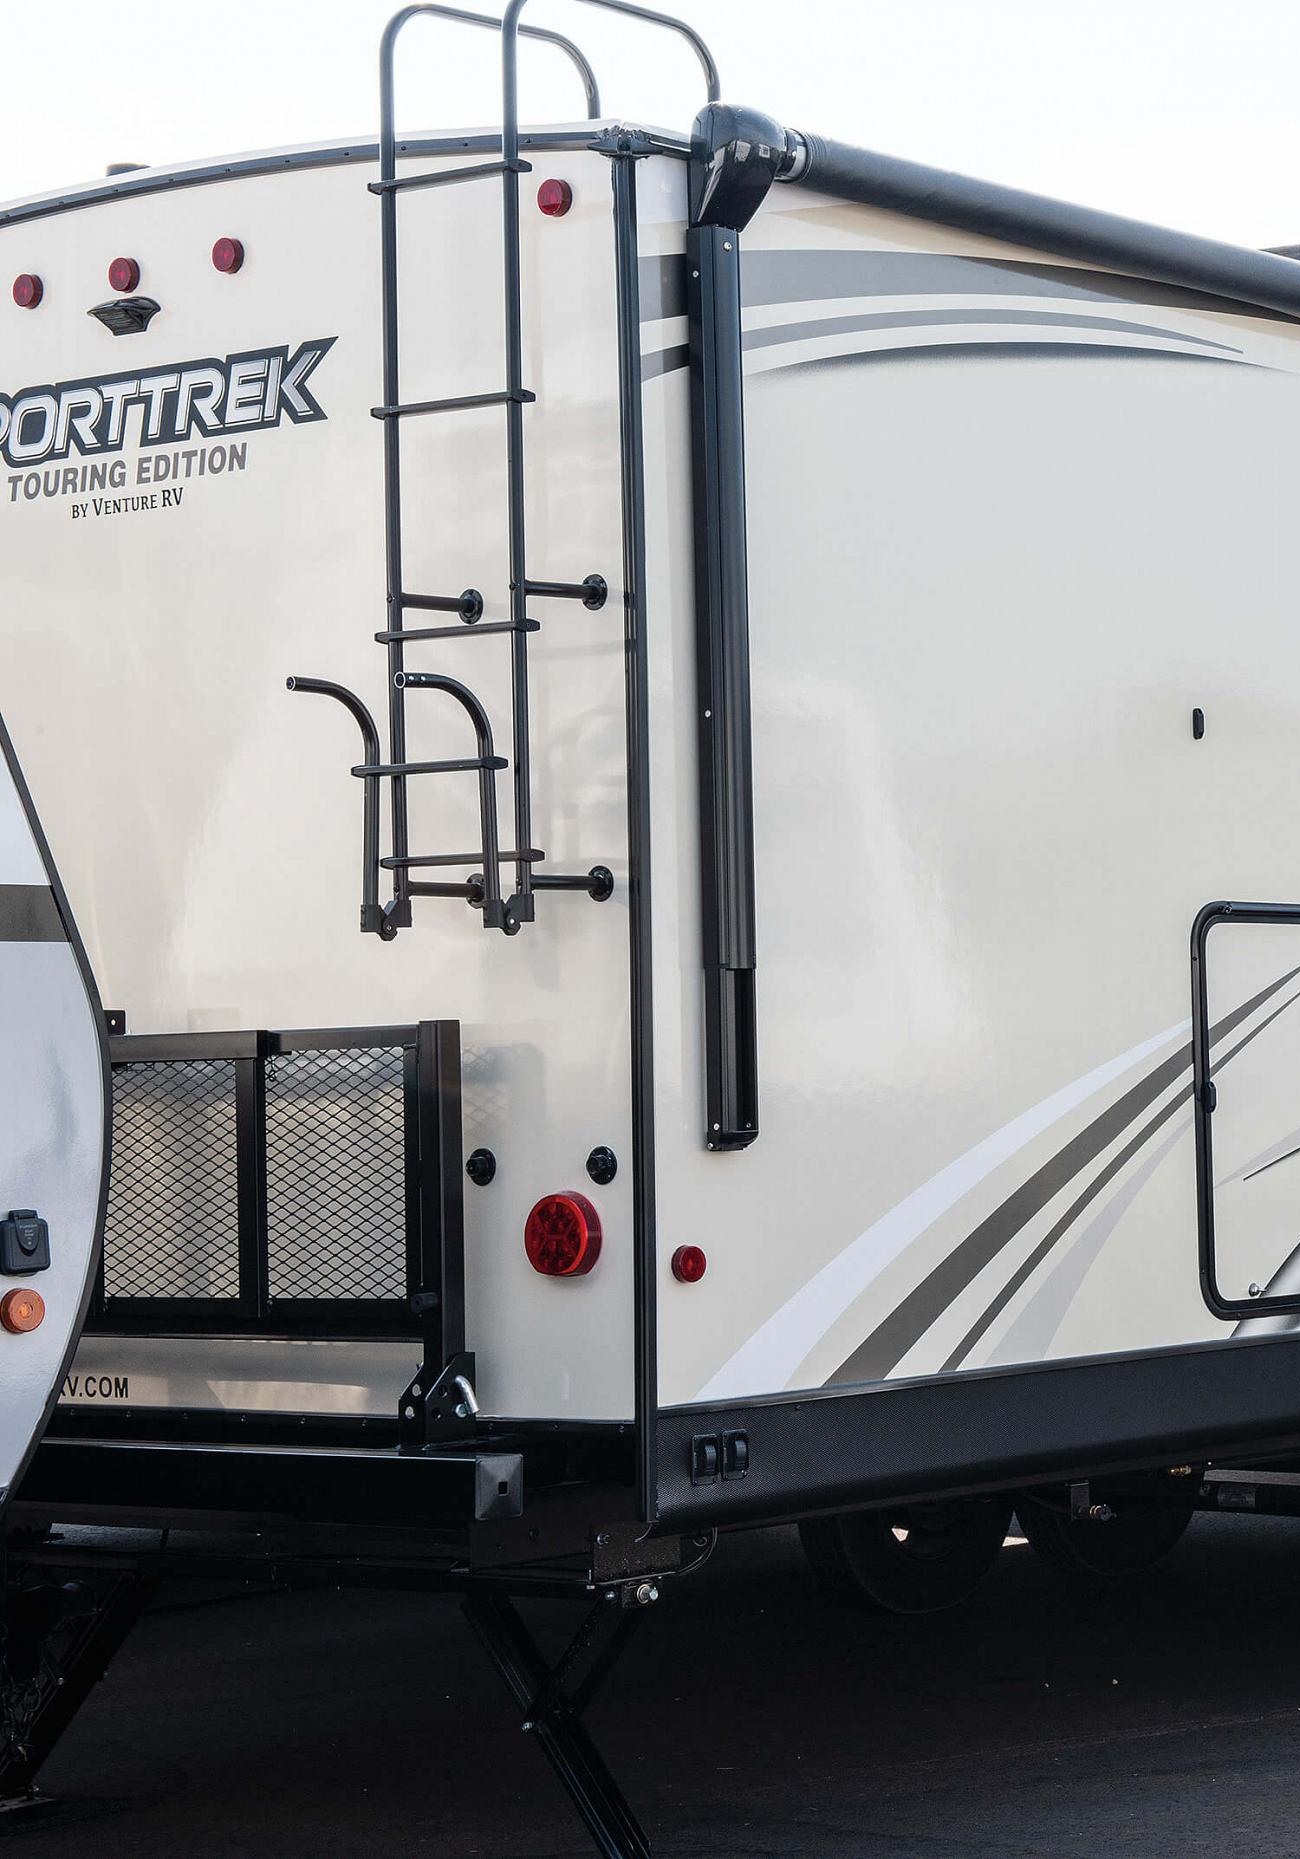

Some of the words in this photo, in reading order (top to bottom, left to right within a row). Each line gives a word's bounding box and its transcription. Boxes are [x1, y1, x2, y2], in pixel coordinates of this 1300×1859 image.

[8, 460, 126, 502] TOURING
[136, 442, 248, 485] EDITION
[71, 503, 89, 519] BY
[161, 487, 184, 508] RV
[60, 1376, 128, 1398] V.COM
